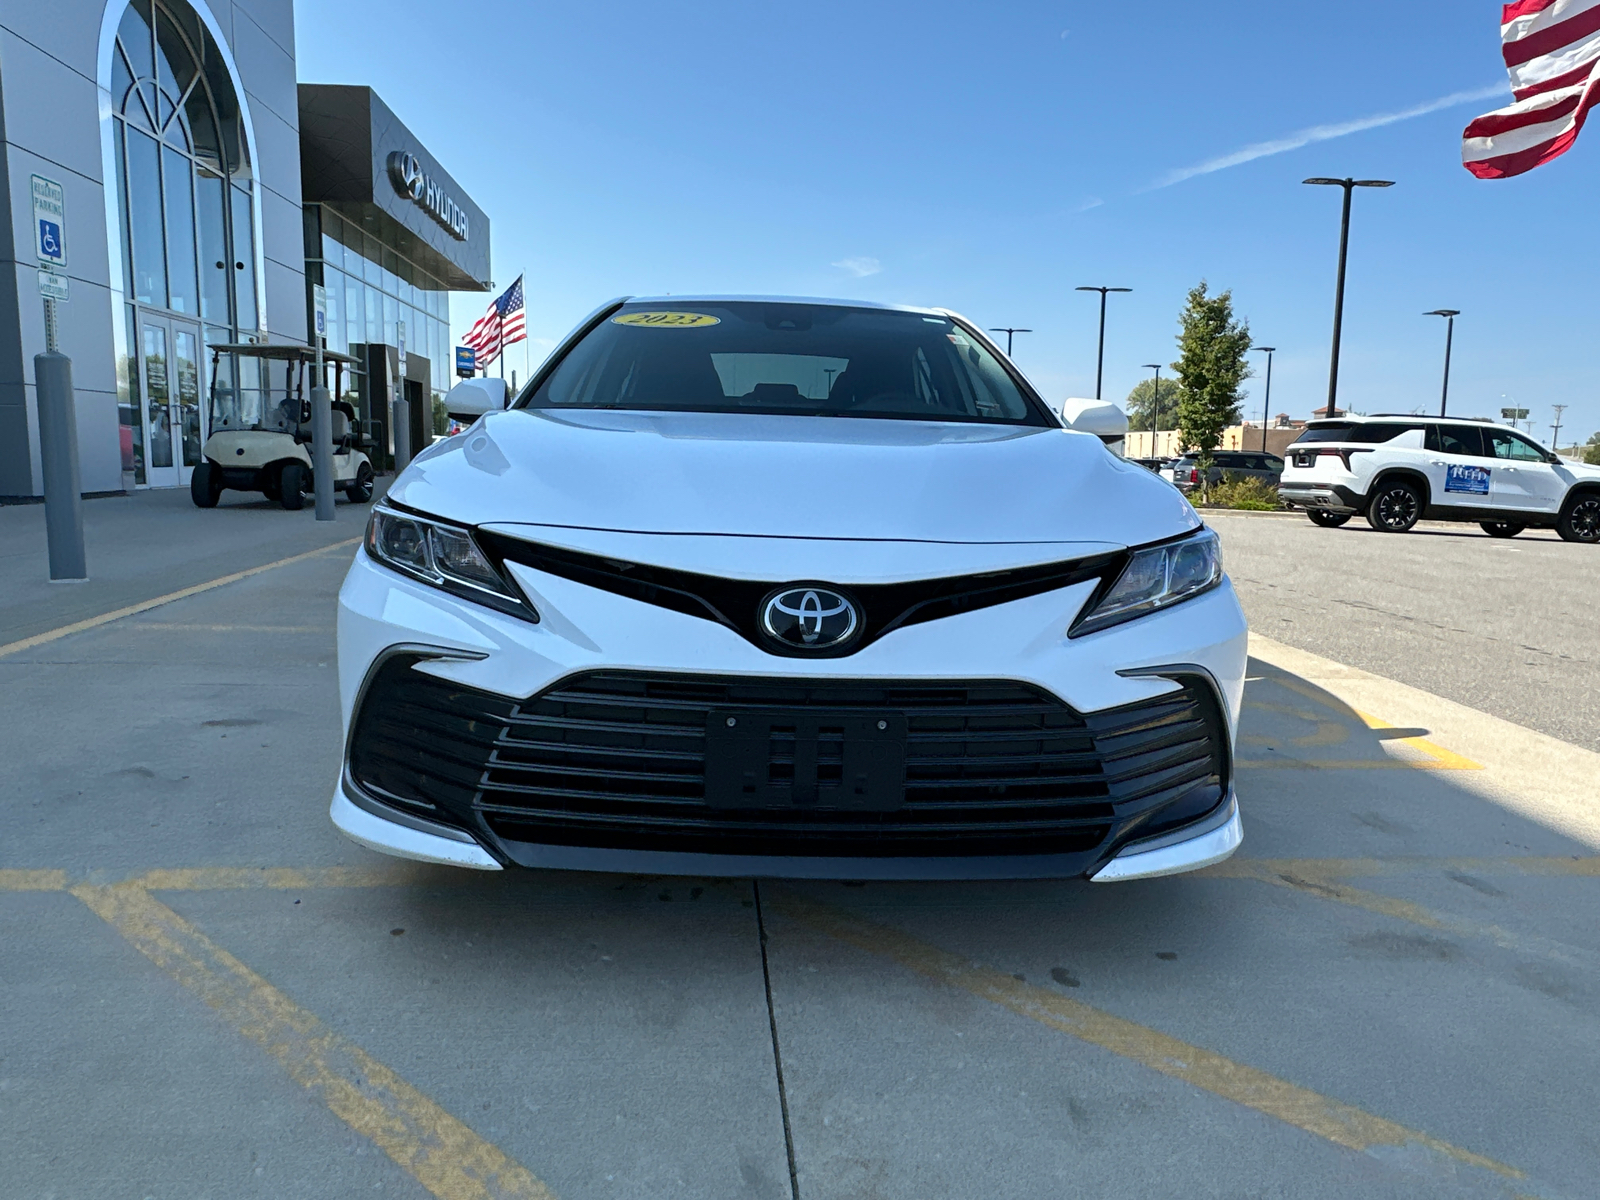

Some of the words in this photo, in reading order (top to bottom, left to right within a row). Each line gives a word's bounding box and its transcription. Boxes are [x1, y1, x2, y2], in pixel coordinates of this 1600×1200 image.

[34, 182, 61, 201] RESERVED
[34, 197, 62, 217] PARKING
[425, 174, 469, 241] HYUNDAI
[627, 314, 702, 325] 2023
